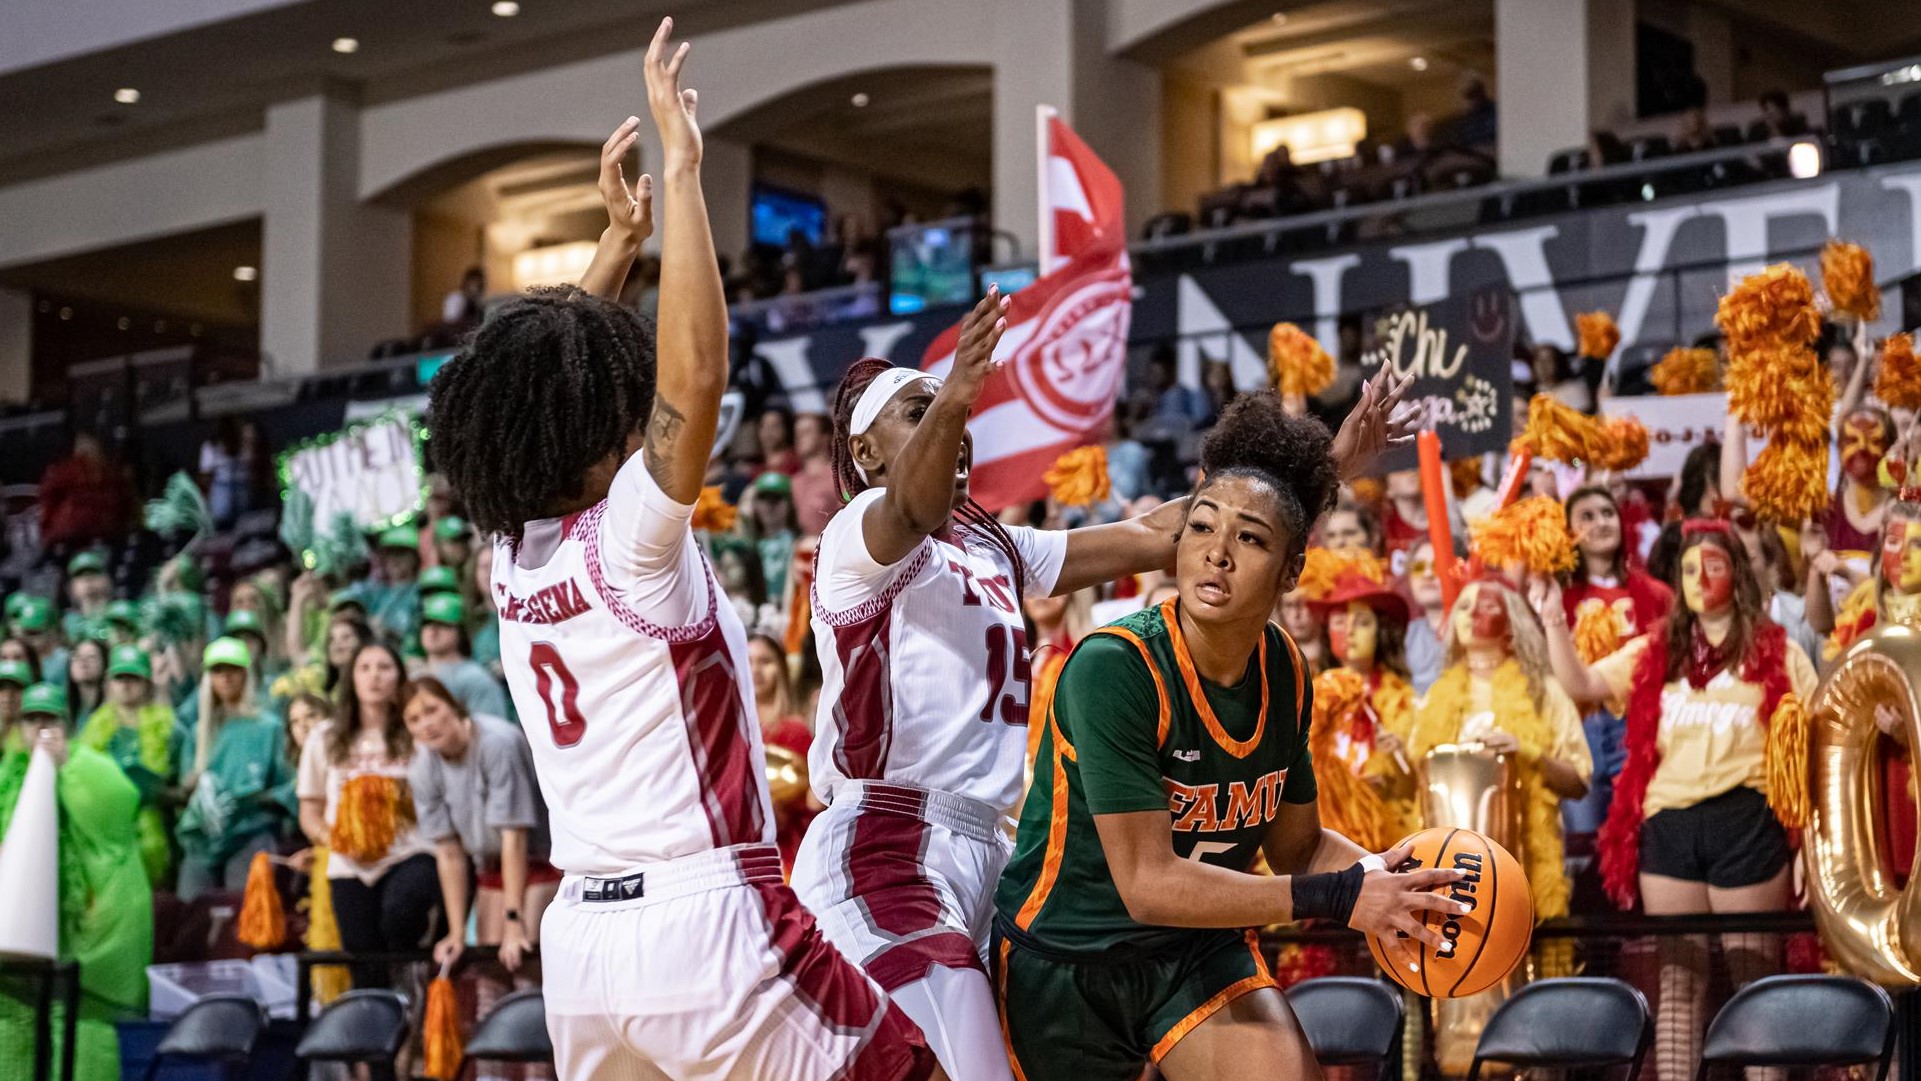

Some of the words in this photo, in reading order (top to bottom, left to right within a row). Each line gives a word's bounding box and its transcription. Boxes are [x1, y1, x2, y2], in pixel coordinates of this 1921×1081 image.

[1391, 310, 1469, 379] Chi
[529, 641, 587, 749] 0
[980, 623, 1032, 727] 15
[1161, 767, 1289, 832] FAMU
